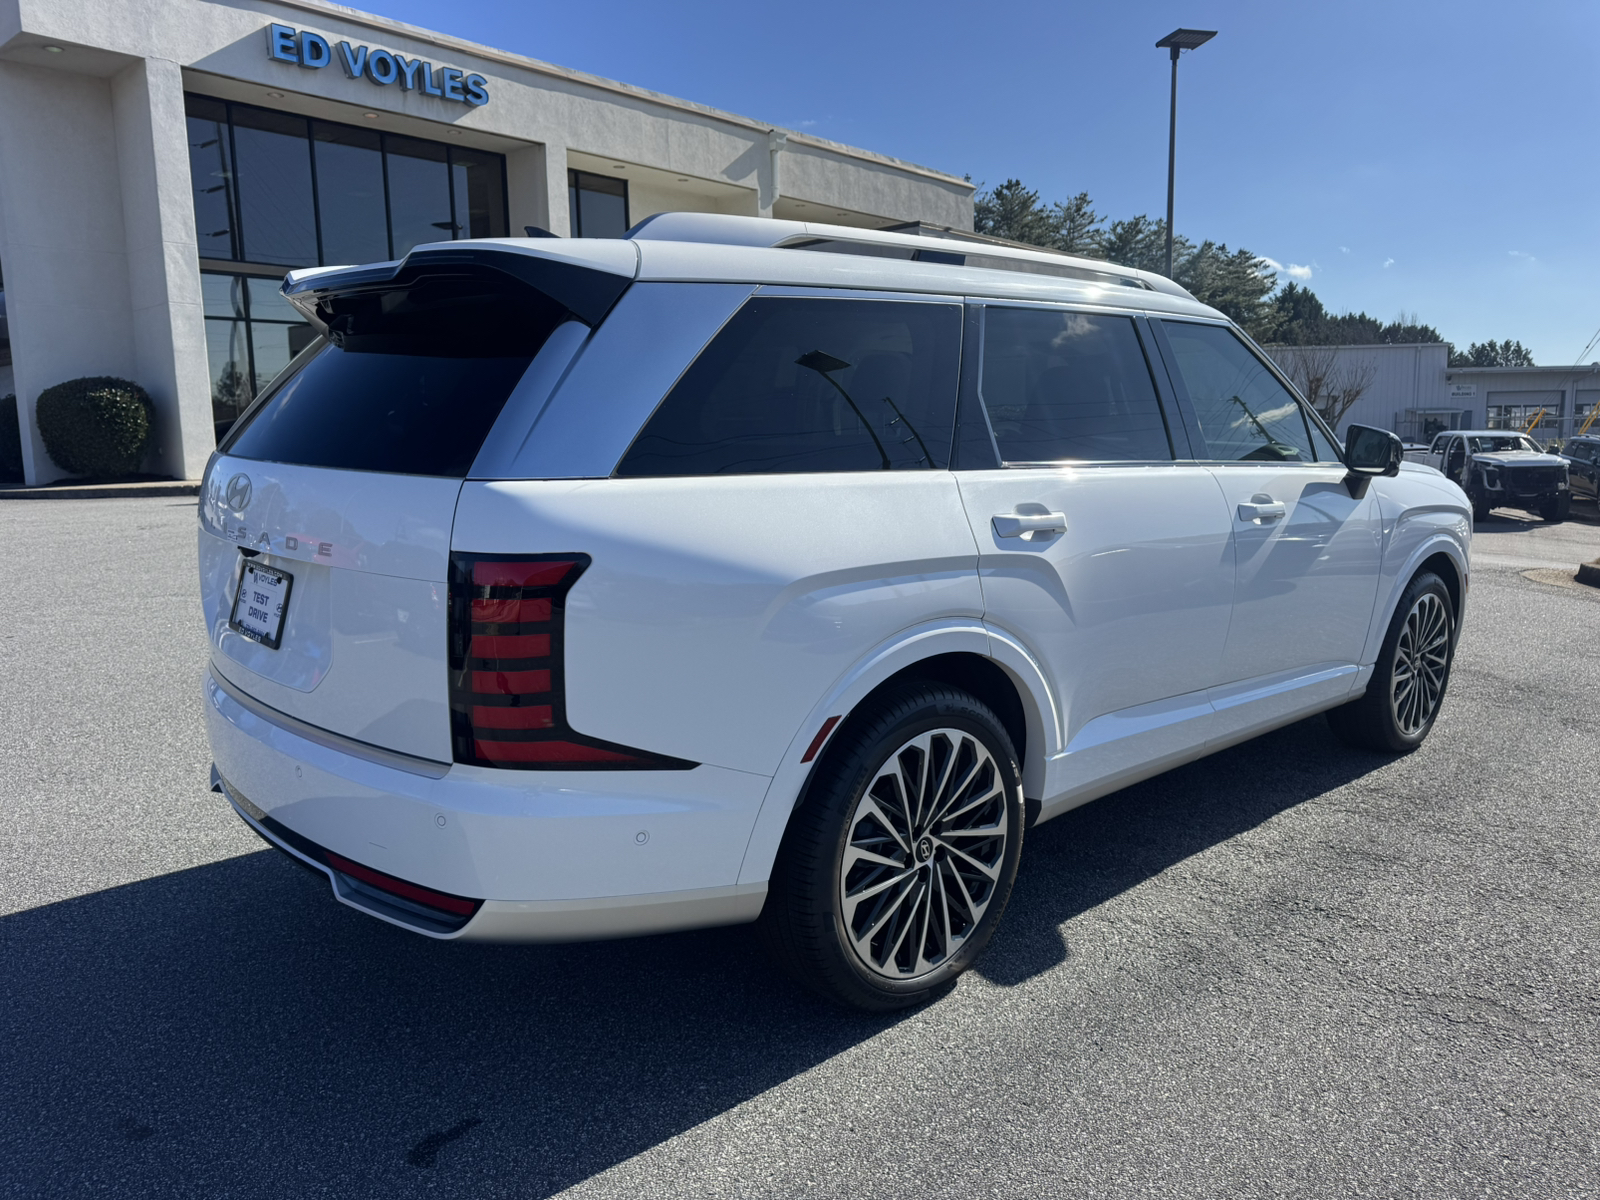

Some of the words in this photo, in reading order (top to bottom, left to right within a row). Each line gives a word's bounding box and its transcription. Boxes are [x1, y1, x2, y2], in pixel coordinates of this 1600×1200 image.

[268, 22, 331, 69] ED
[336, 41, 489, 107] VOYLES
[253, 591, 269, 606] TEST
[248, 605, 269, 623] DRIVE
